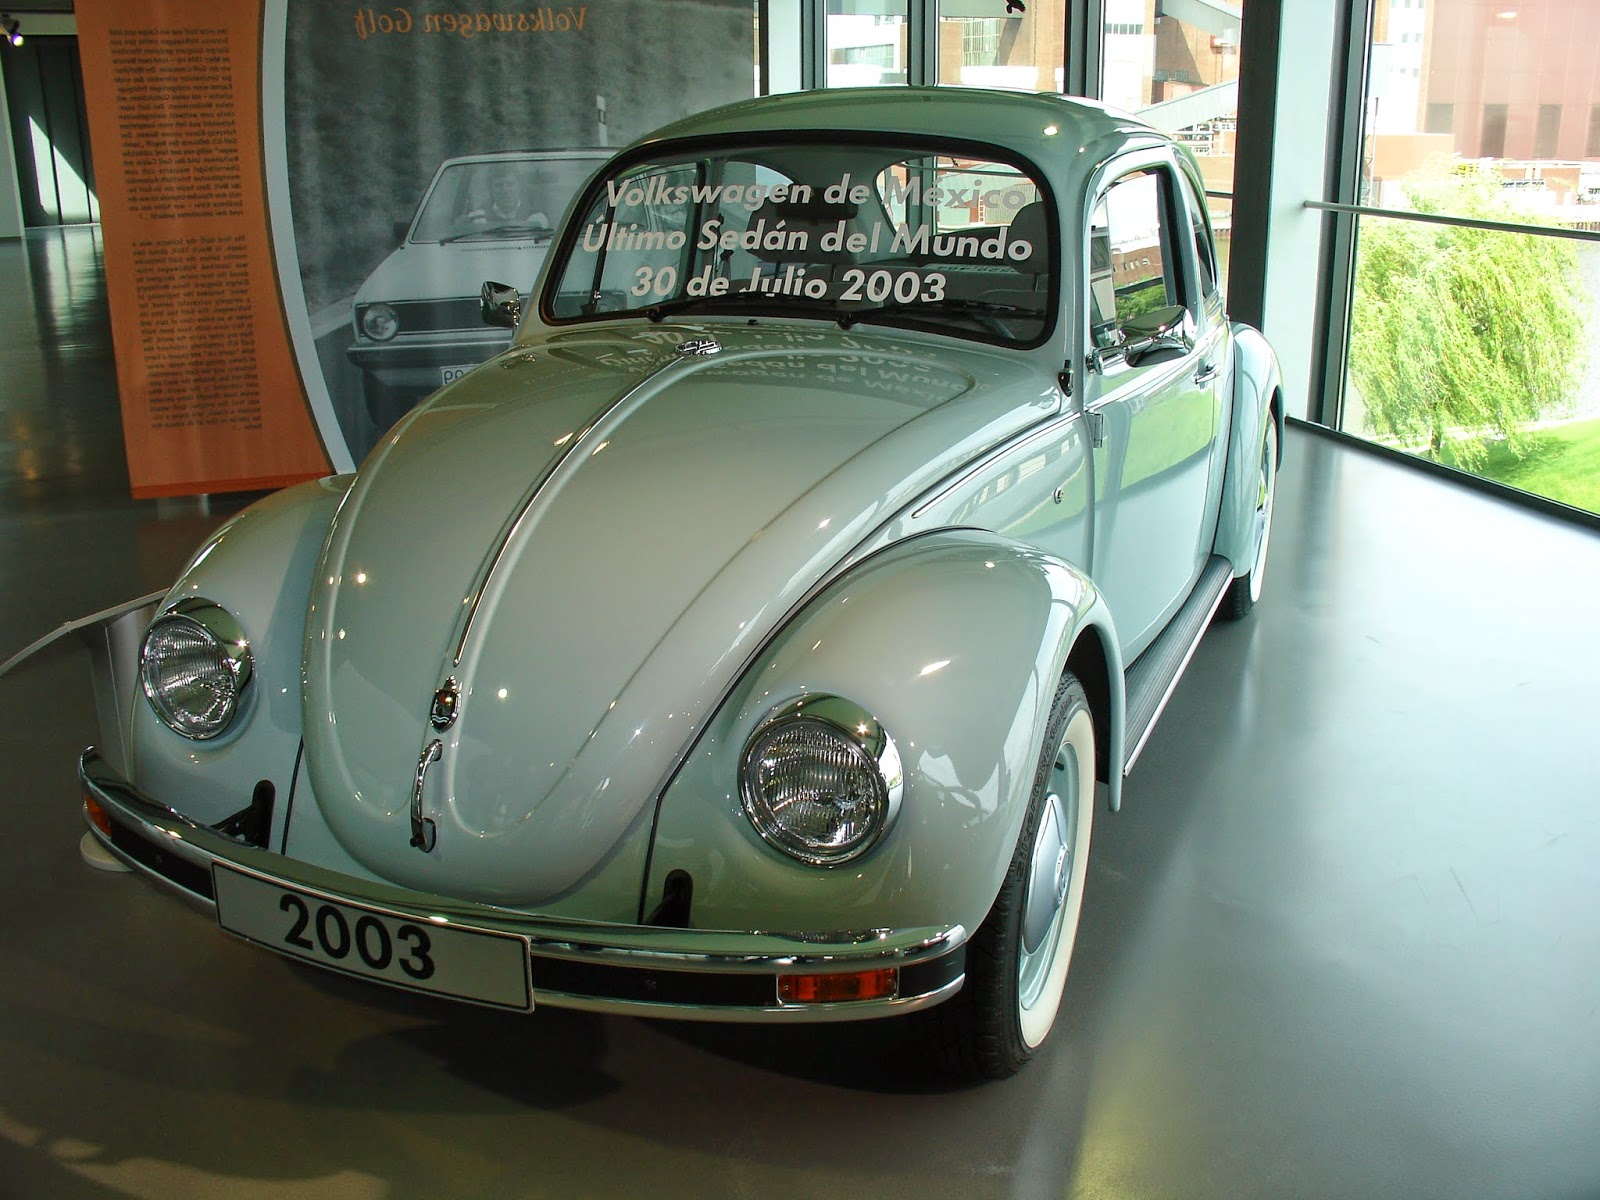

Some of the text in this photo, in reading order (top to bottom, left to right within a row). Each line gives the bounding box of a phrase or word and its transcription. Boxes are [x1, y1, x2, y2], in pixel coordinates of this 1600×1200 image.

[606, 173, 1027, 211] Volkswagen de México
[582, 214, 1033, 261] Último Sedán del Mundo
[631, 266, 947, 303] 30 de Julio 2003
[279, 893, 435, 980] 2003
